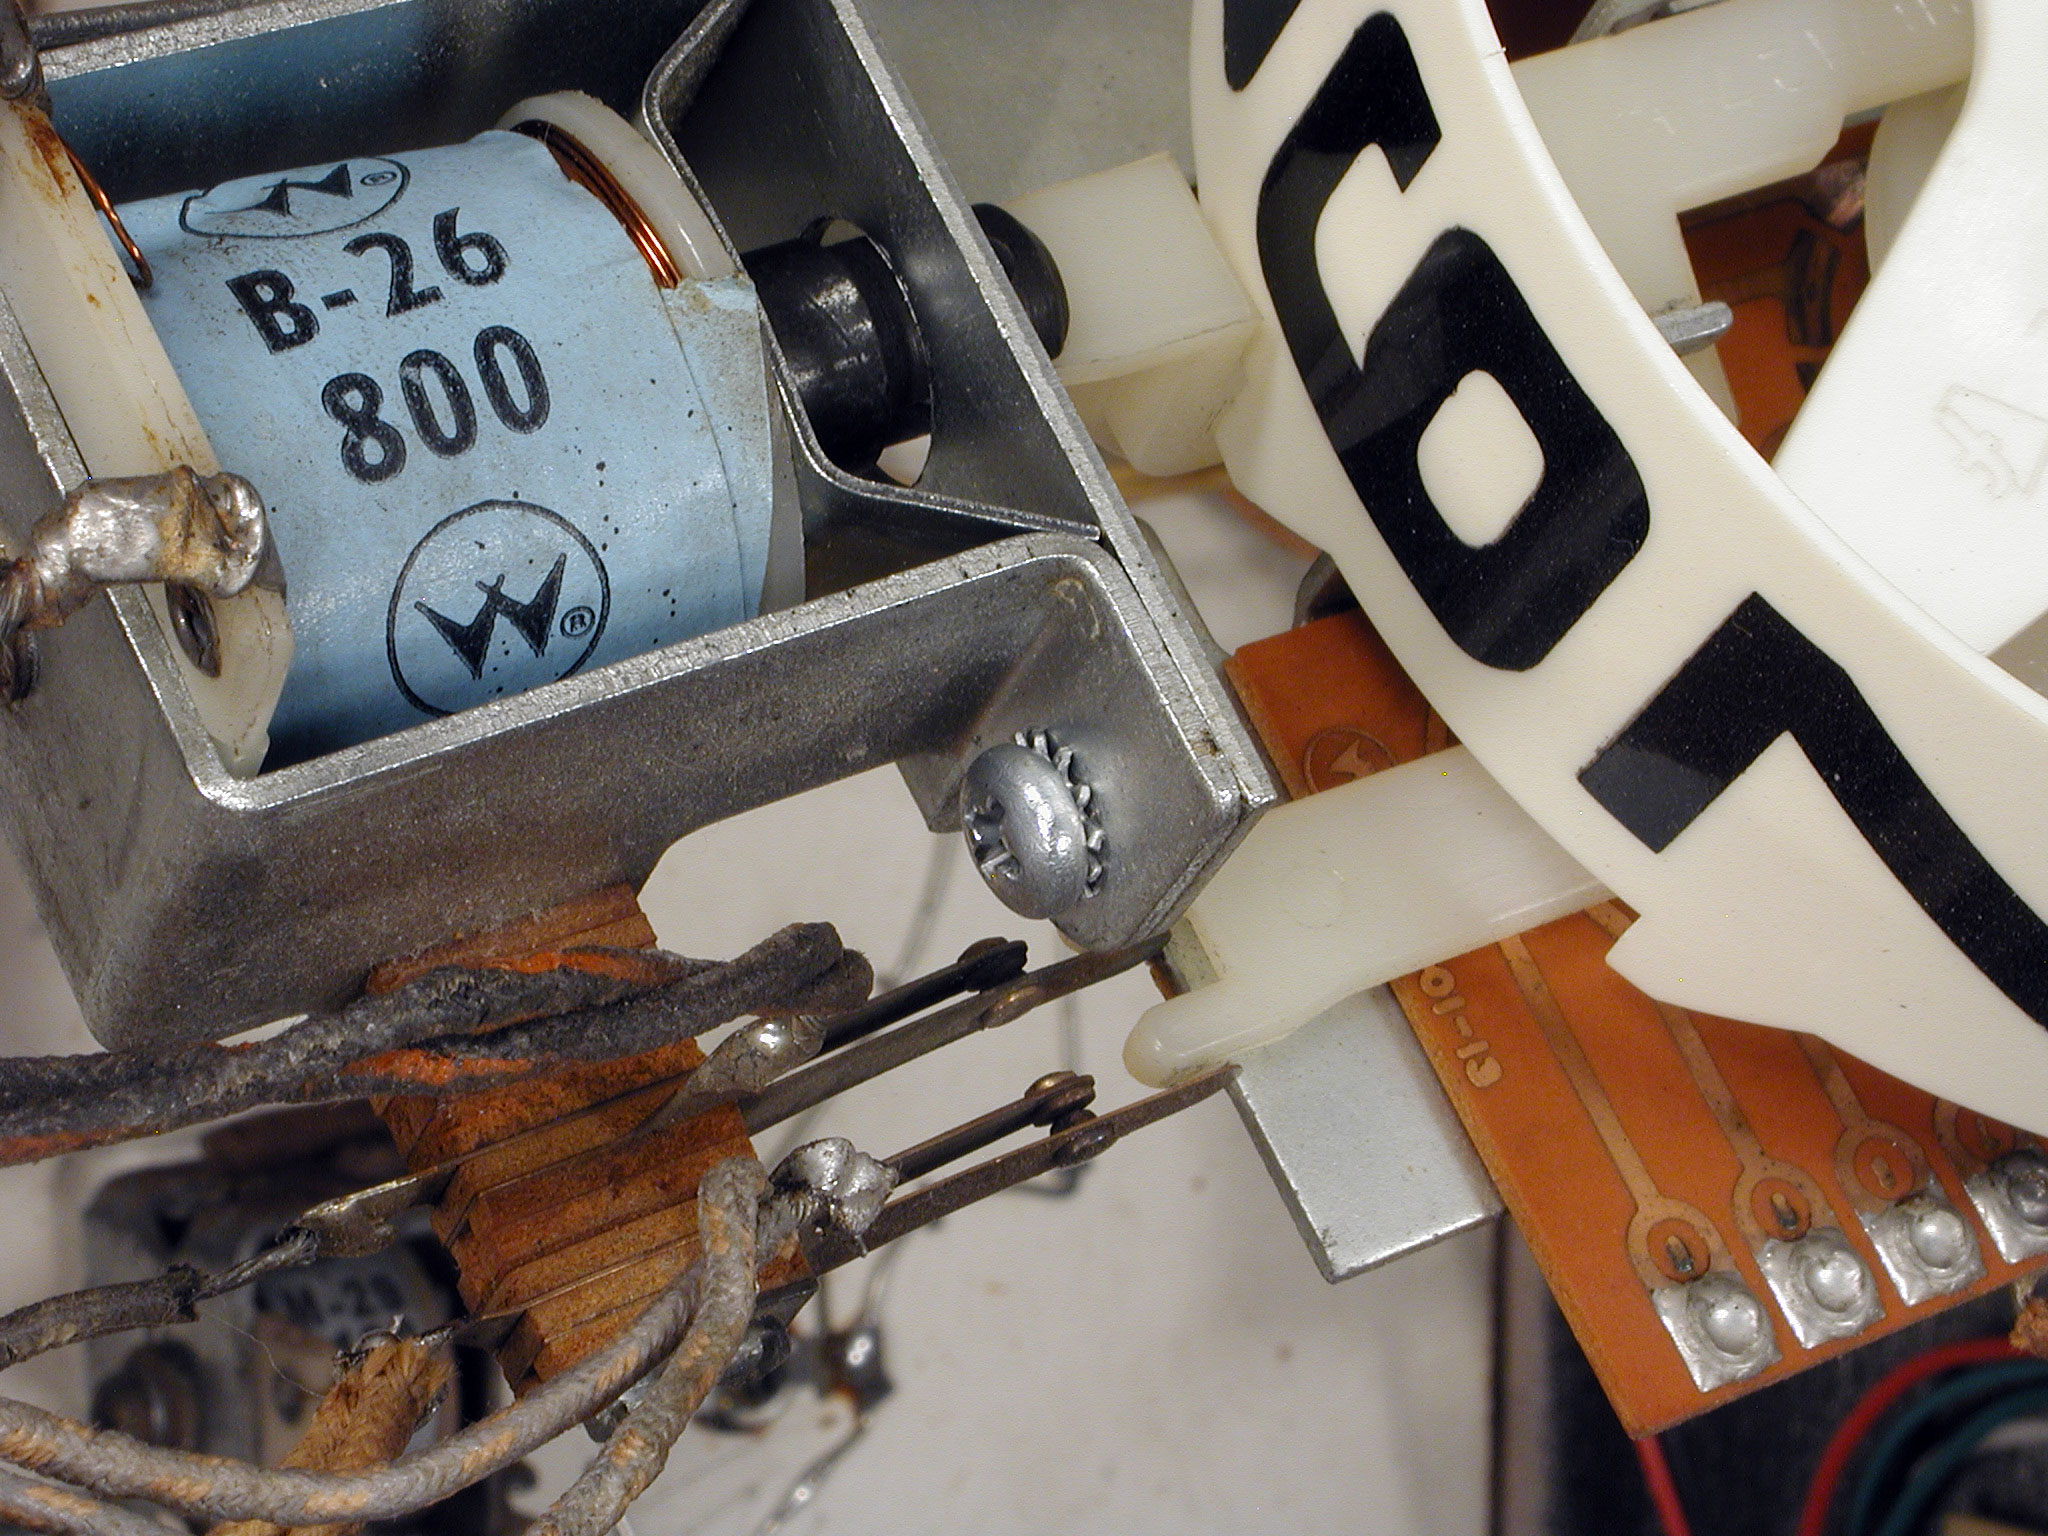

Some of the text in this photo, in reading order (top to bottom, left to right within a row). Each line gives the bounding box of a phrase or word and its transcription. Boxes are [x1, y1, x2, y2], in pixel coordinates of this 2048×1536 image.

[225, 206, 510, 354] B-26
[1256, 10, 1650, 671] 6
[321, 325, 550, 484] 800
